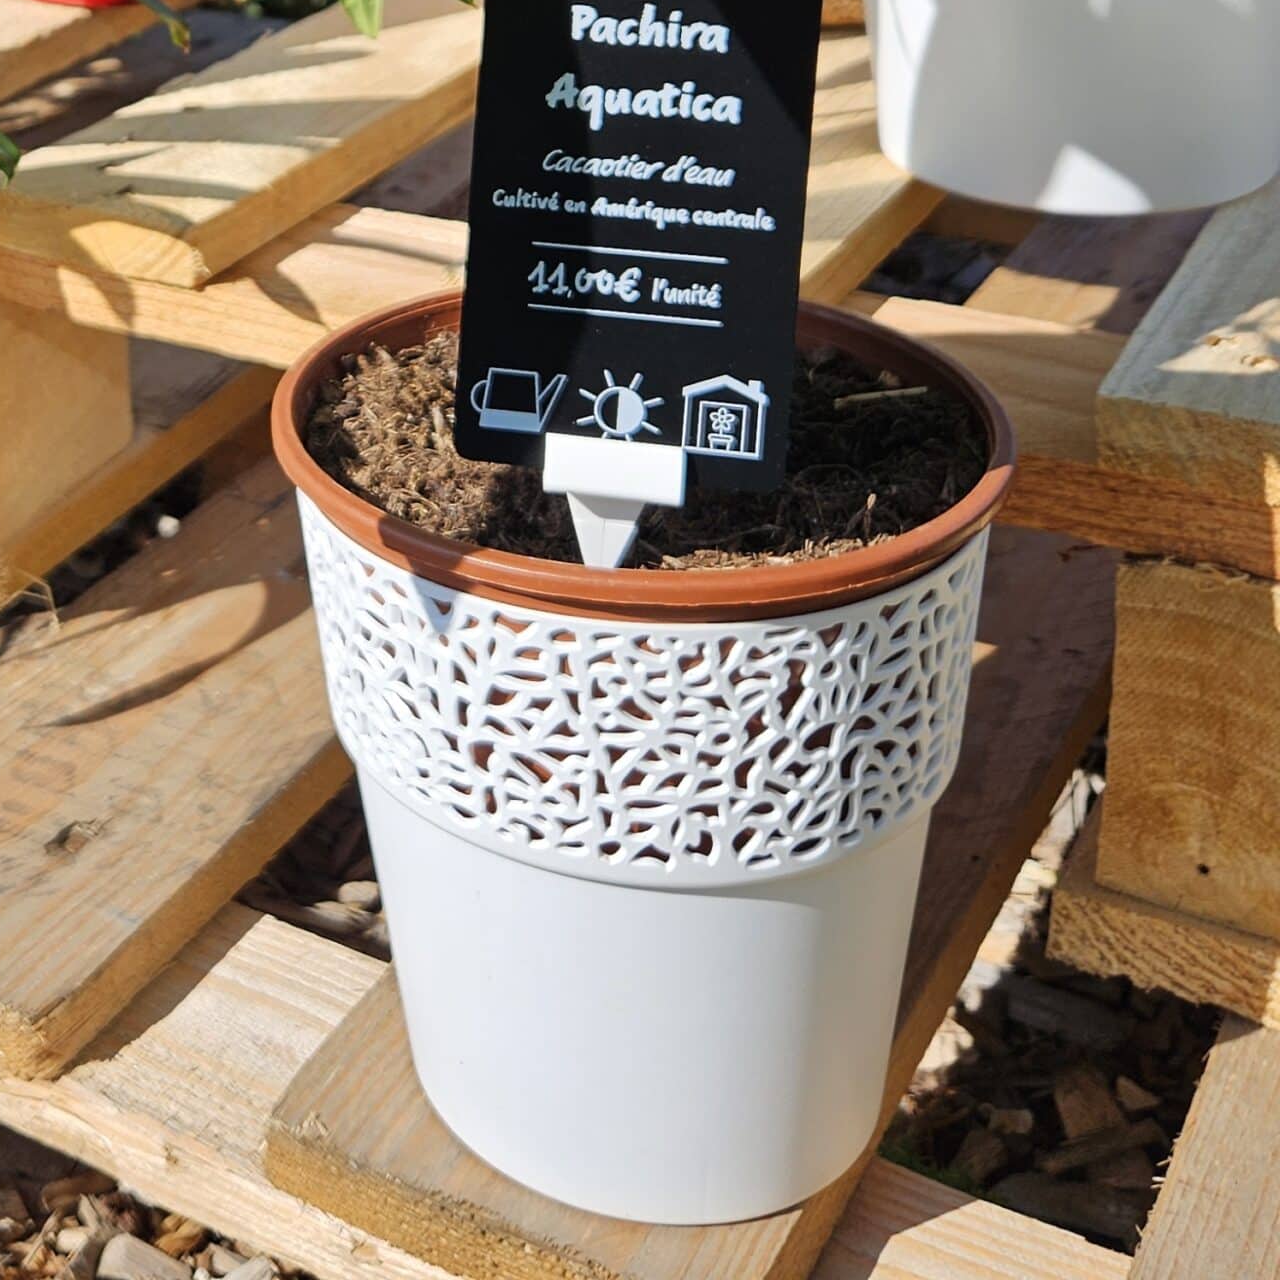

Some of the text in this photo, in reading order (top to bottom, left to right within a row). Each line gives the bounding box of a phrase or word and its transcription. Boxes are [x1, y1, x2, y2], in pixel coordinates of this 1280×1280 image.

[570, 3, 731, 54] Pachira
[545, 72, 743, 131] Aquatica
[542, 149, 736, 188] Cacaotier d'eau
[492, 188, 777, 232] Cultivé en Amérique centrale
[527, 261, 723, 309] 11,00€ l'unité
